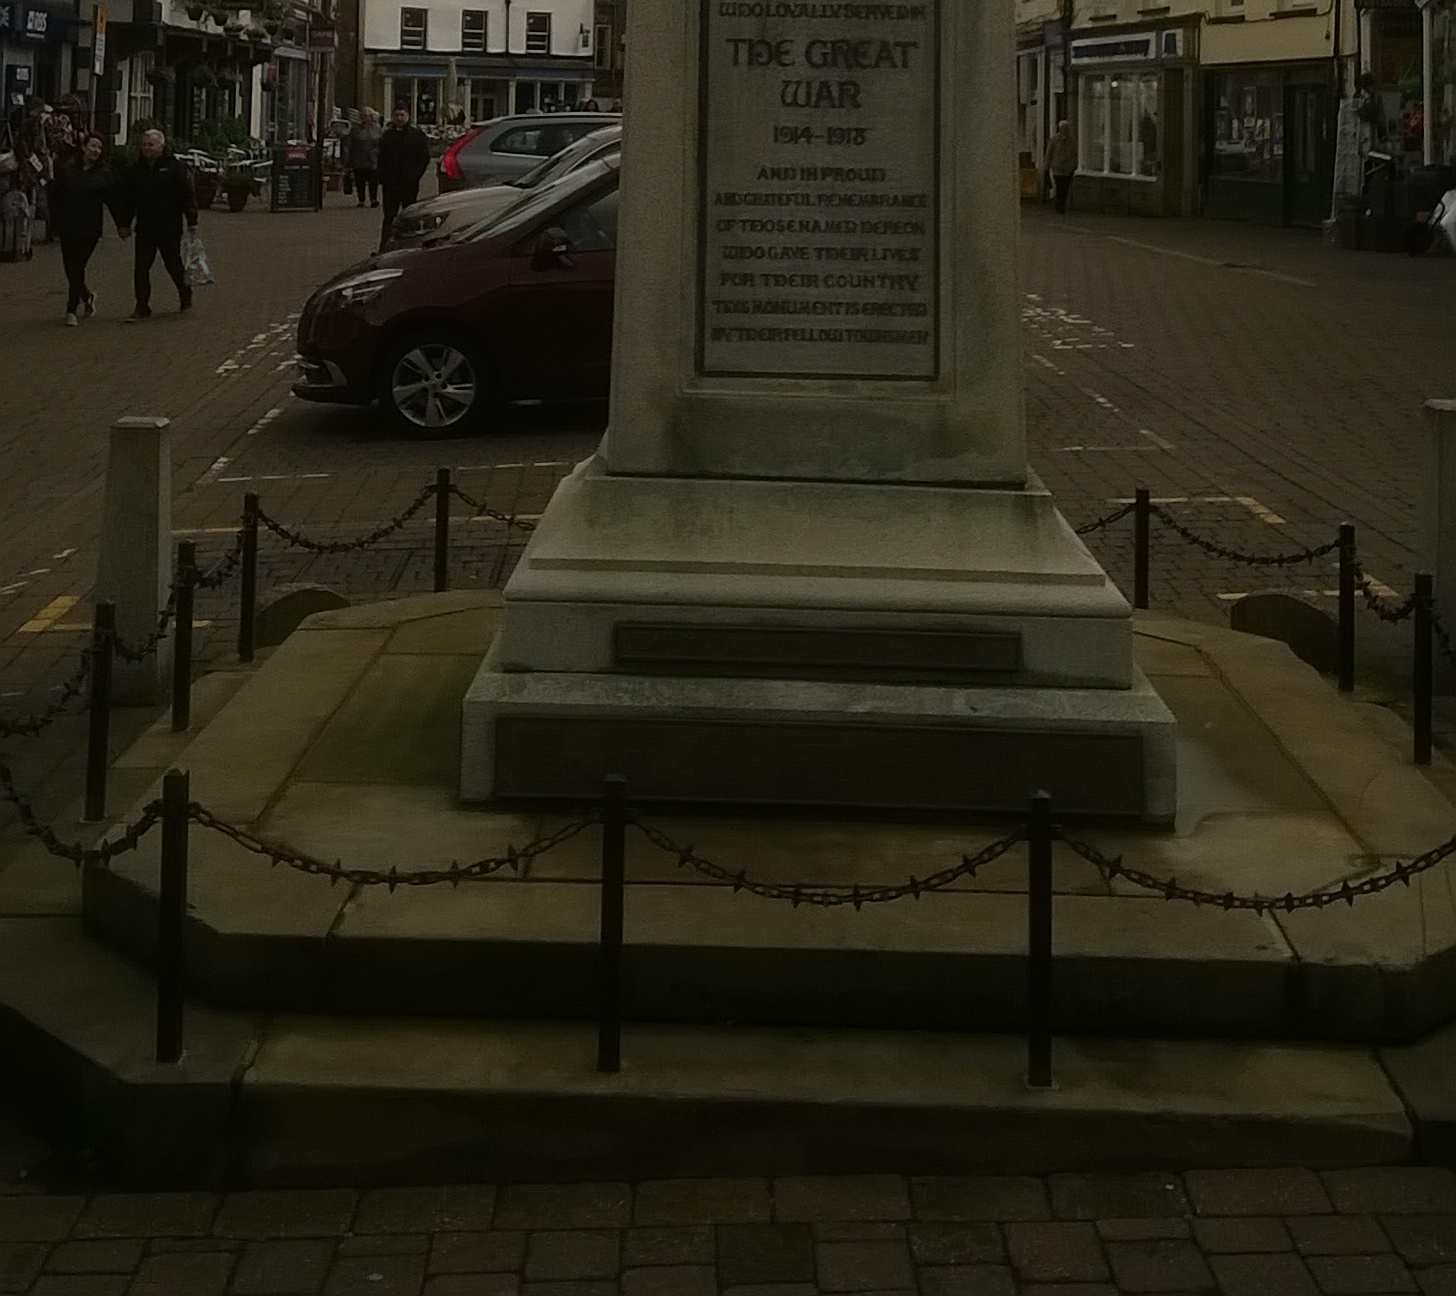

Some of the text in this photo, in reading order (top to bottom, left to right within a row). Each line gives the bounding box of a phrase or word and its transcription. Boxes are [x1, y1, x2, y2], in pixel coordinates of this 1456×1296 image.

[719, 2, 764, 18] WHO
[765, 2, 842, 19] LOYALLY
[843, 4, 909, 20] SERVED
[725, 38, 919, 69] THE GREAT
[780, 80, 862, 109] WAR
[773, 125, 872, 146] 1914-1918
[757, 167, 887, 182] AND IN PROUD
[743, 193, 816, 207] GRATEFUL
[817, 193, 928, 208] REMEMBRANCE
[716, 219, 926, 235] OF THOSE NAMED HEREON
[722, 246, 923, 262] WHO GAVE THEIR LIVES
[720, 273, 920, 291] FOR THEIR COUNTRY
[752, 301, 844, 315] MONUMENT
[845, 302, 861, 316] IS
[861, 302, 929, 317] ERECTED
[784, 328, 843, 343] FELLOW
